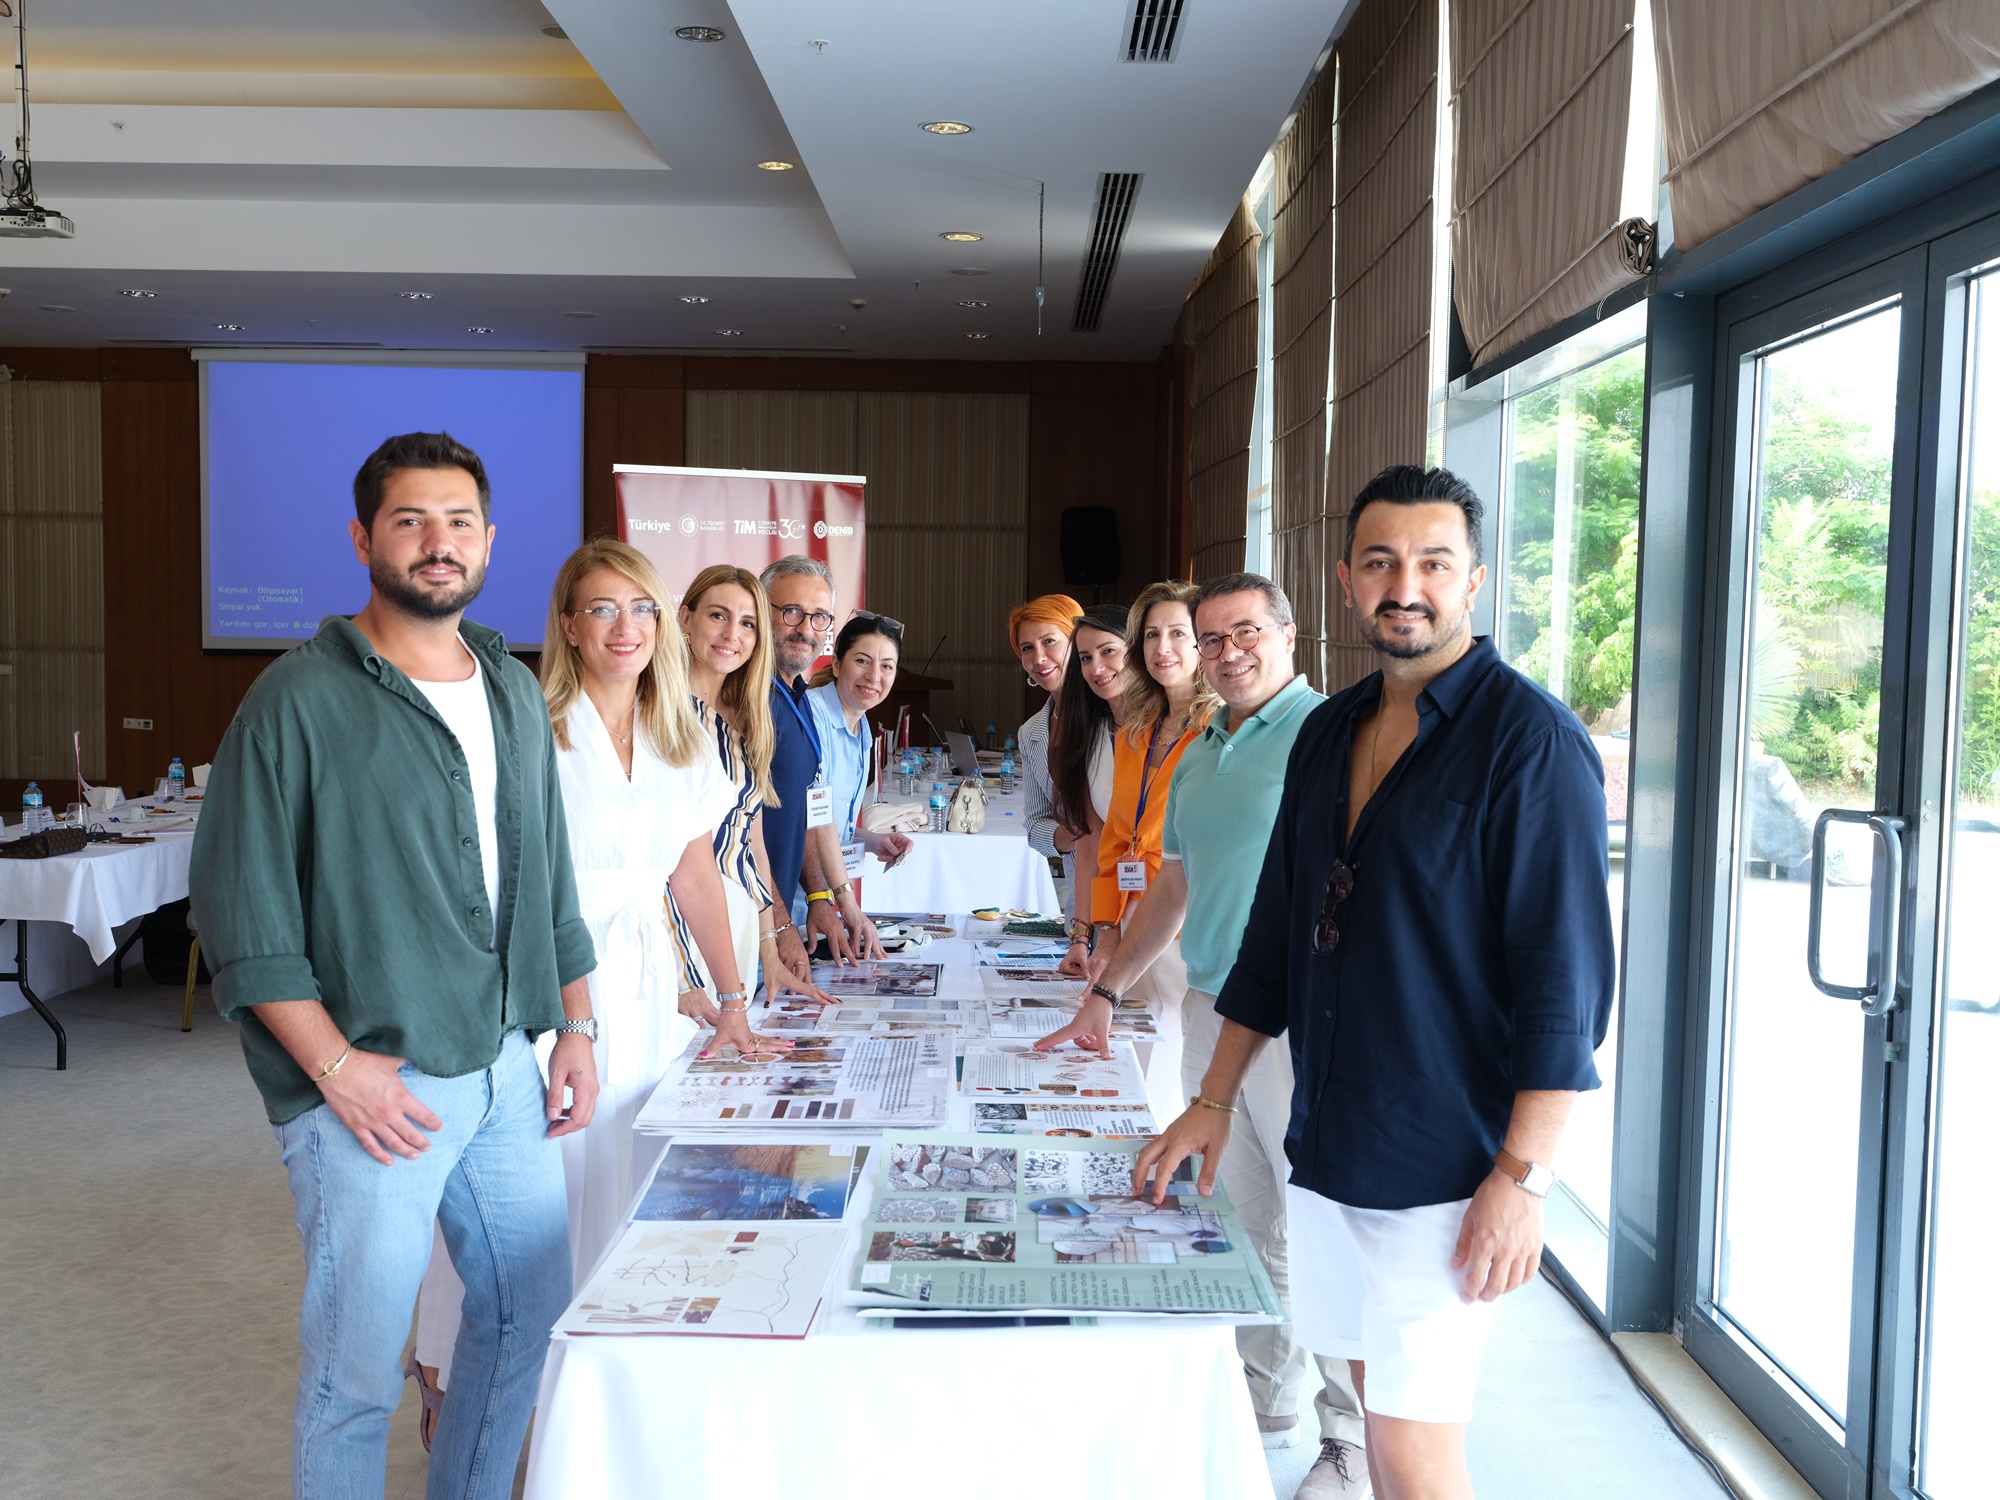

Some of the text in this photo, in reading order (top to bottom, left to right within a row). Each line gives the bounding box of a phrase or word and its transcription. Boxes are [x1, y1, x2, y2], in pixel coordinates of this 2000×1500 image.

[628, 519, 671, 533] Türkiye
[218, 586, 303, 595] Kaynak: Bilgisayar1
[257, 595, 304, 604] (Otomatik)
[218, 603, 264, 611] Sinyal yok.
[219, 620, 251, 628] Yardımı
[253, 621, 271, 629] gör.
[273, 621, 289, 629] için
